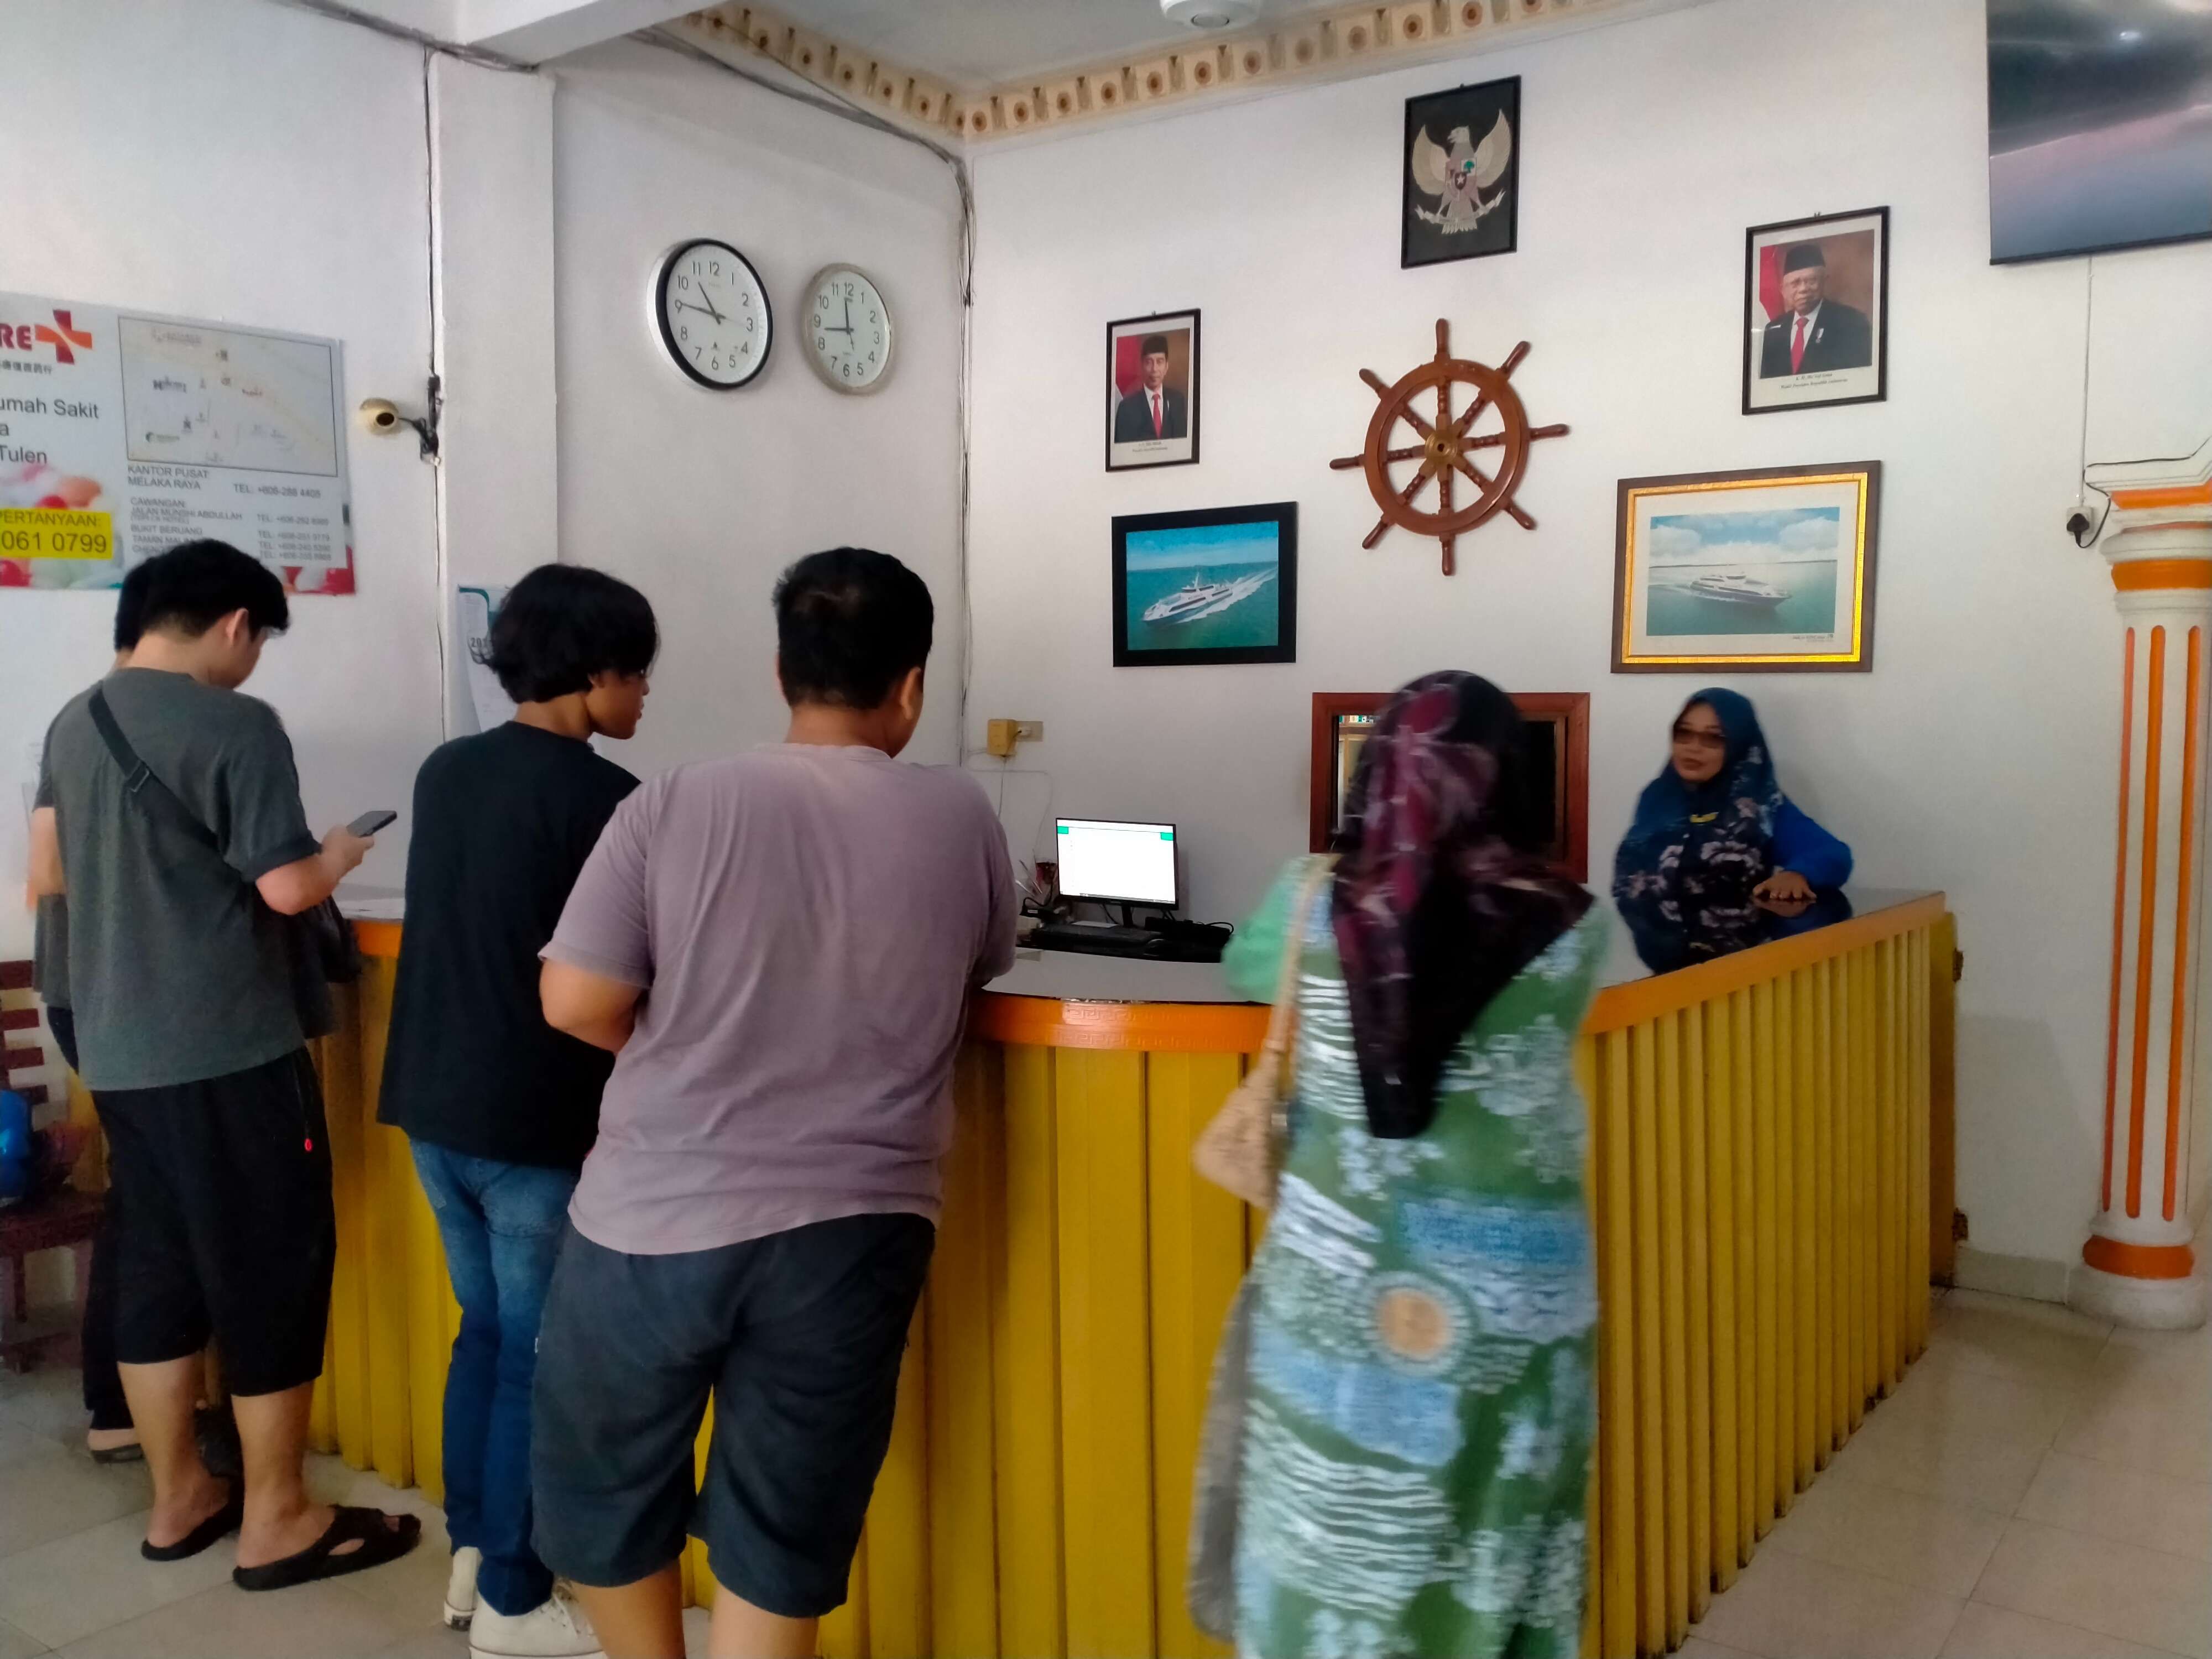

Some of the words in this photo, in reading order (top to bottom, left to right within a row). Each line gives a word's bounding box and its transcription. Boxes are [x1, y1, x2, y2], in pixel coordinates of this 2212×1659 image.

[692, 261, 701, 275] 11
[709, 261, 719, 276] 12
[678, 275, 688, 290] 10
[832, 282, 838, 296] 11
[844, 282, 854, 296] 12
[675, 299, 682, 314] 9
[742, 293, 748, 307] 2
[818, 295, 828, 310] 10
[814, 314, 821, 328] 9
[869, 311, 876, 323] 2
[746, 317, 753, 332] 3
[680, 326, 688, 341] 8
[873, 332, 880, 345] 3
[740, 342, 748, 354] 4
[818, 337, 825, 350] 8
[695, 347, 702, 360] 7
[868, 351, 874, 363] 4
[711, 356, 718, 371] 6
[729, 355, 736, 368] 5
[831, 356, 837, 369] 7
[843, 364, 850, 377] 6
[857, 363, 864, 375] 5
[54, 399, 99, 419] Sakit
[0, 445, 47, 463] Tulen
[128, 465, 173, 477] KANTOR
[175, 468, 208, 478] PUSAT
[128, 476, 171, 488] MELAKA
[174, 479, 201, 490] RAYA
[0, 510, 101, 527] ERTANYAAN:
[2, 530, 41, 550] 061
[52, 533, 107, 553] 0799
